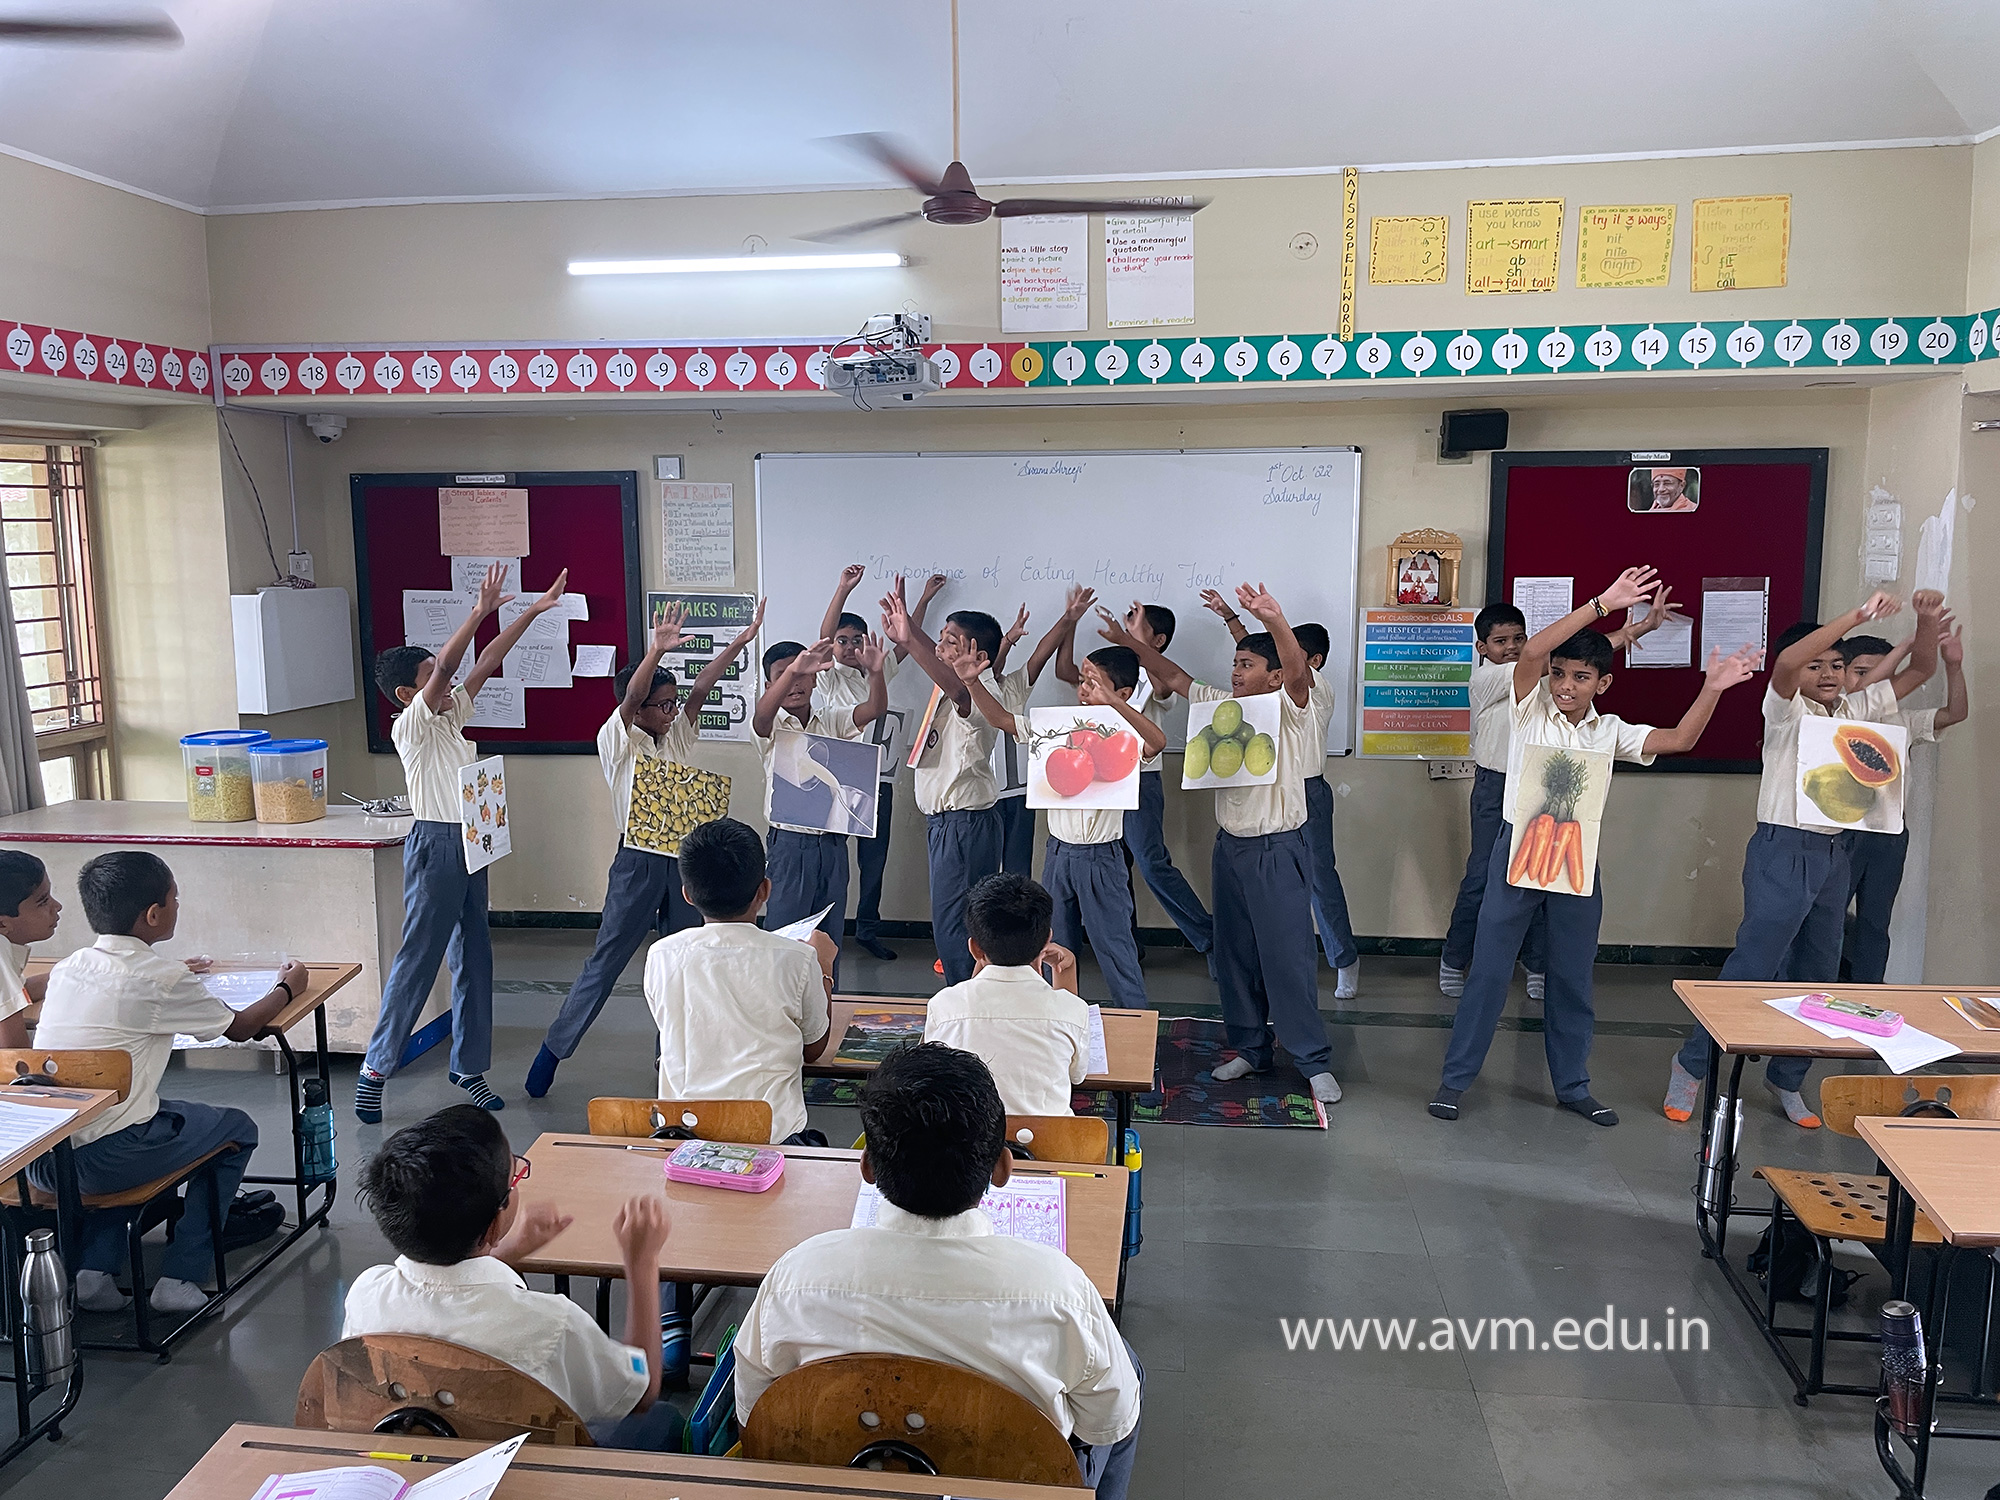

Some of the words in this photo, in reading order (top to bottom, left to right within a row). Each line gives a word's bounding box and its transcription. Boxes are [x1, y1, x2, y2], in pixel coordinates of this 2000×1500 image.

[1345, 167, 1357, 214] WAYS
[1478, 208, 1499, 219] use
[1504, 206, 1541, 218] words
[1111, 218, 1127, 226] Give
[1138, 216, 1174, 228] powerful
[1486, 220, 1506, 232] you
[1512, 218, 1542, 229] know
[1592, 214, 1608, 231] try
[1625, 215, 1635, 226] 3
[1637, 214, 1667, 231] ways
[1123, 226, 1147, 234] detail
[1112, 237, 1128, 246] Use
[1140, 236, 1187, 248] meaningful
[1475, 237, 1496, 250] art
[1606, 232, 1624, 244] nit
[1049, 245, 1069, 254] story
[1112, 245, 1155, 258] quotation
[1605, 246, 1628, 257] nite
[1006, 256, 1026, 264] paint
[1037, 255, 1063, 265] picture
[1112, 255, 1150, 266] Challenge
[1154, 255, 1171, 267] your
[1343, 231, 1355, 290] SPELL
[1042, 266, 1062, 275] topic
[1112, 265, 1121, 273] to
[1603, 258, 1637, 276] night
[1006, 278, 1021, 287] give
[1024, 276, 1068, 289] background
[1474, 275, 1491, 288] all
[1505, 276, 1526, 290] fall
[1716, 278, 1736, 288] call
[1014, 286, 1056, 297] information
[1151, 316, 1165, 325] the
[1341, 290, 1353, 342] WORDS
[1973, 328, 1985, 346] 21
[9, 338, 31, 357] -27
[43, 343, 65, 362] -26
[76, 348, 96, 366] -25
[106, 353, 126, 370] -24
[136, 357, 154, 374] -23
[164, 361, 182, 378] -22
[191, 365, 207, 381] -21
[226, 366, 250, 382] -20
[263, 366, 287, 382] -19
[301, 365, 325, 381] -18
[339, 365, 362, 381] -17
[377, 365, 401, 380] -16
[415, 364, 439, 380] -15
[453, 364, 478, 380] -14
[492, 363, 516, 379] -13
[531, 363, 555, 379] -12
[572, 363, 593, 379] -11
[609, 363, 634, 378] -10
[653, 362, 669, 378] -9
[693, 362, 709, 377] -8
[733, 361, 748, 376] -7
[773, 361, 789, 376] -6
[979, 358, 993, 373] -1
[1022, 358, 1032, 373] 0
[1066, 357, 1073, 371] 1
[1107, 355, 1117, 370] 2
[1149, 354, 1160, 369] 3
[1192, 353, 1203, 367] 4
[1236, 351, 1246, 367] 5
[1279, 351, 1290, 366] 6
[1323, 349, 1335, 364] 7
[1368, 347, 1379, 363] 8
[1413, 346, 1424, 362] 9
[1454, 345, 1474, 361] 10
[1502, 344, 1519, 359] 11
[1547, 342, 1566, 358] 12
[1593, 340, 1613, 356] 13
[1640, 339, 1660, 355] 14
[1687, 337, 1708, 353] 15
[1735, 336, 1756, 353] 16
[1783, 335, 1804, 351] 17
[1831, 334, 1851, 350] 18
[1879, 333, 1900, 350] 19
[1925, 332, 1949, 349] 20
[451, 489, 475, 502] Strong
[500, 489, 508, 499] of
[1262, 486, 1322, 517] Saturday
[982, 555, 1002, 589] of
[1020, 555, 1076, 584] Eating
[1093, 558, 1165, 600] Healthy
[655, 600, 718, 618] MTAKES
[1431, 613, 1464, 622] GOALS
[1387, 626, 1421, 634] RESPECT
[688, 663, 736, 676] RESED
[1394, 688, 1418, 696] RAISE
[1431, 688, 1459, 696] HAND
[1394, 697, 1413, 706] before
